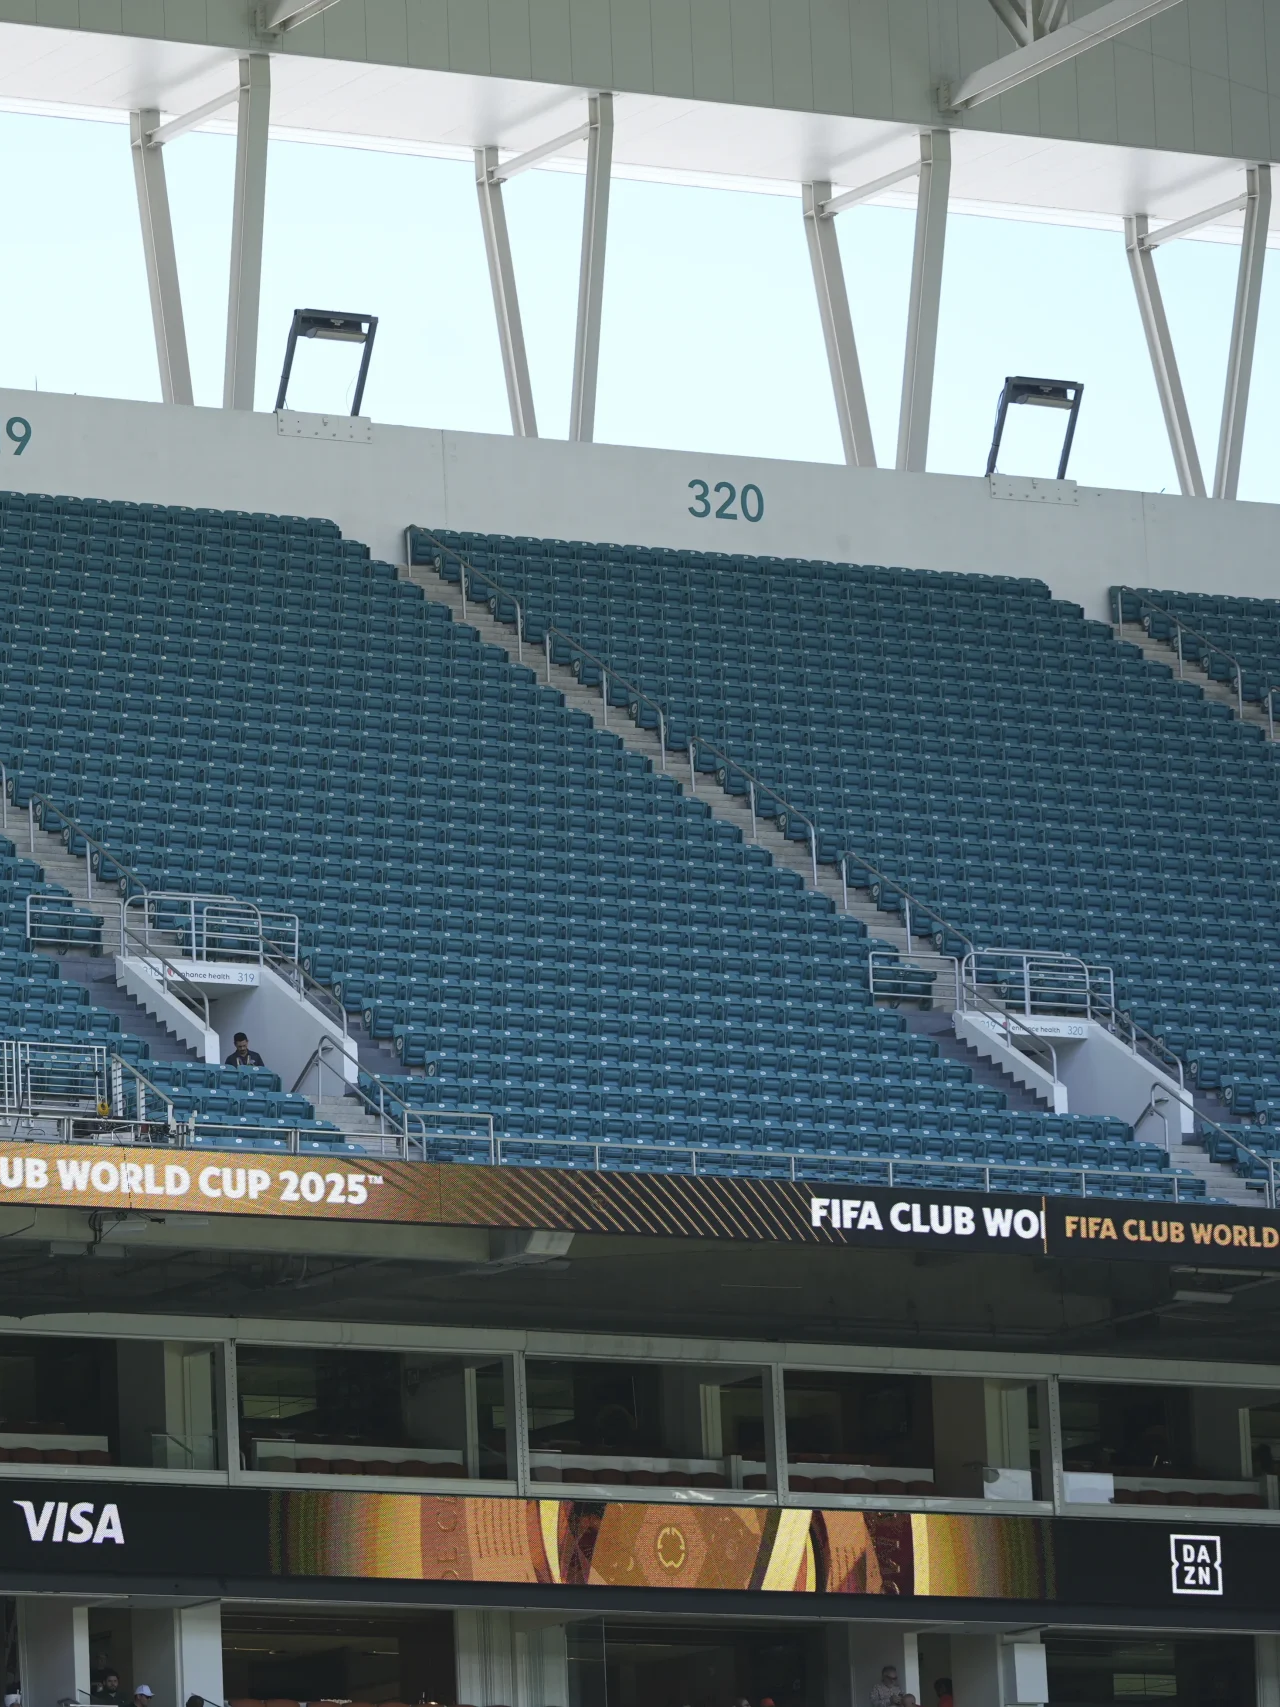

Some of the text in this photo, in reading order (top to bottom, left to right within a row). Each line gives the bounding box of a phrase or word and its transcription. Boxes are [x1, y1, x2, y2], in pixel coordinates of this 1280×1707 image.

[687, 478, 765, 523] 320
[179, 970, 207, 979] nhance
[208, 972, 231, 980] health
[237, 972, 255, 983] 319
[1040, 1026, 1061, 1034] health
[1067, 1025, 1084, 1036] 320
[56, 1159, 191, 1197] WORLD
[198, 1166, 271, 1200] CUP
[810, 1197, 884, 1231] FIFA
[889, 1202, 976, 1236] CLUB
[1065, 1215, 1280, 1248] FIFA CLUB WORLD
[13, 1500, 125, 1544] VISA
